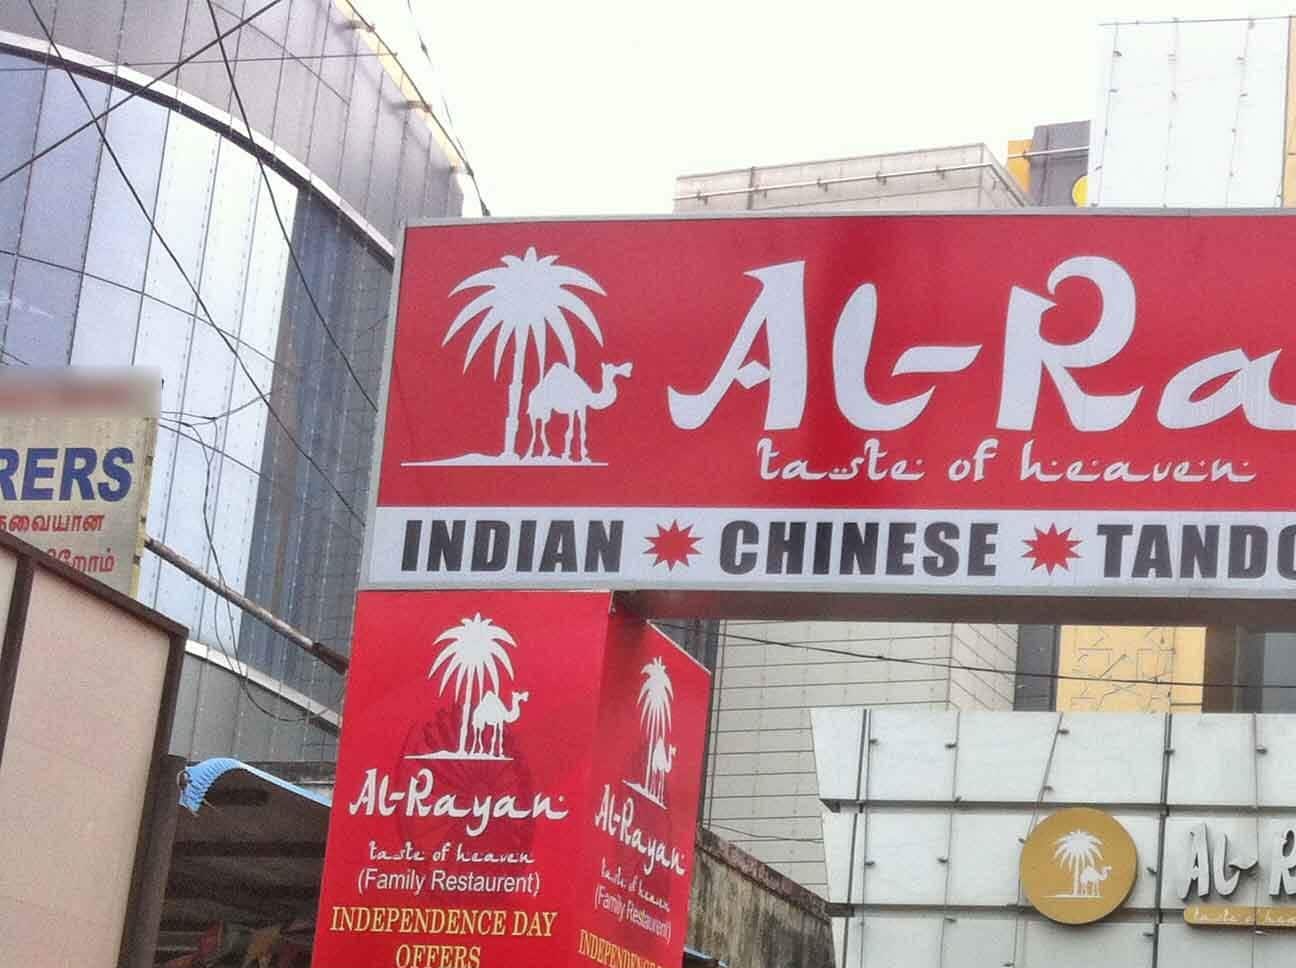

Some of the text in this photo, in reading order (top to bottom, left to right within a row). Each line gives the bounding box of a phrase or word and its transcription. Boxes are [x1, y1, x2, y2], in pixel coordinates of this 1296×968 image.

[757, 438, 1256, 483] taste of heaven
[402, 520, 624, 573] INDIAN
[719, 520, 999, 576] CHINESE
[369, 840, 534, 865] taste of heaven
[357, 868, 541, 897] (Family Restaurent)
[330, 906, 558, 937] INDEPENDENCE DAY
